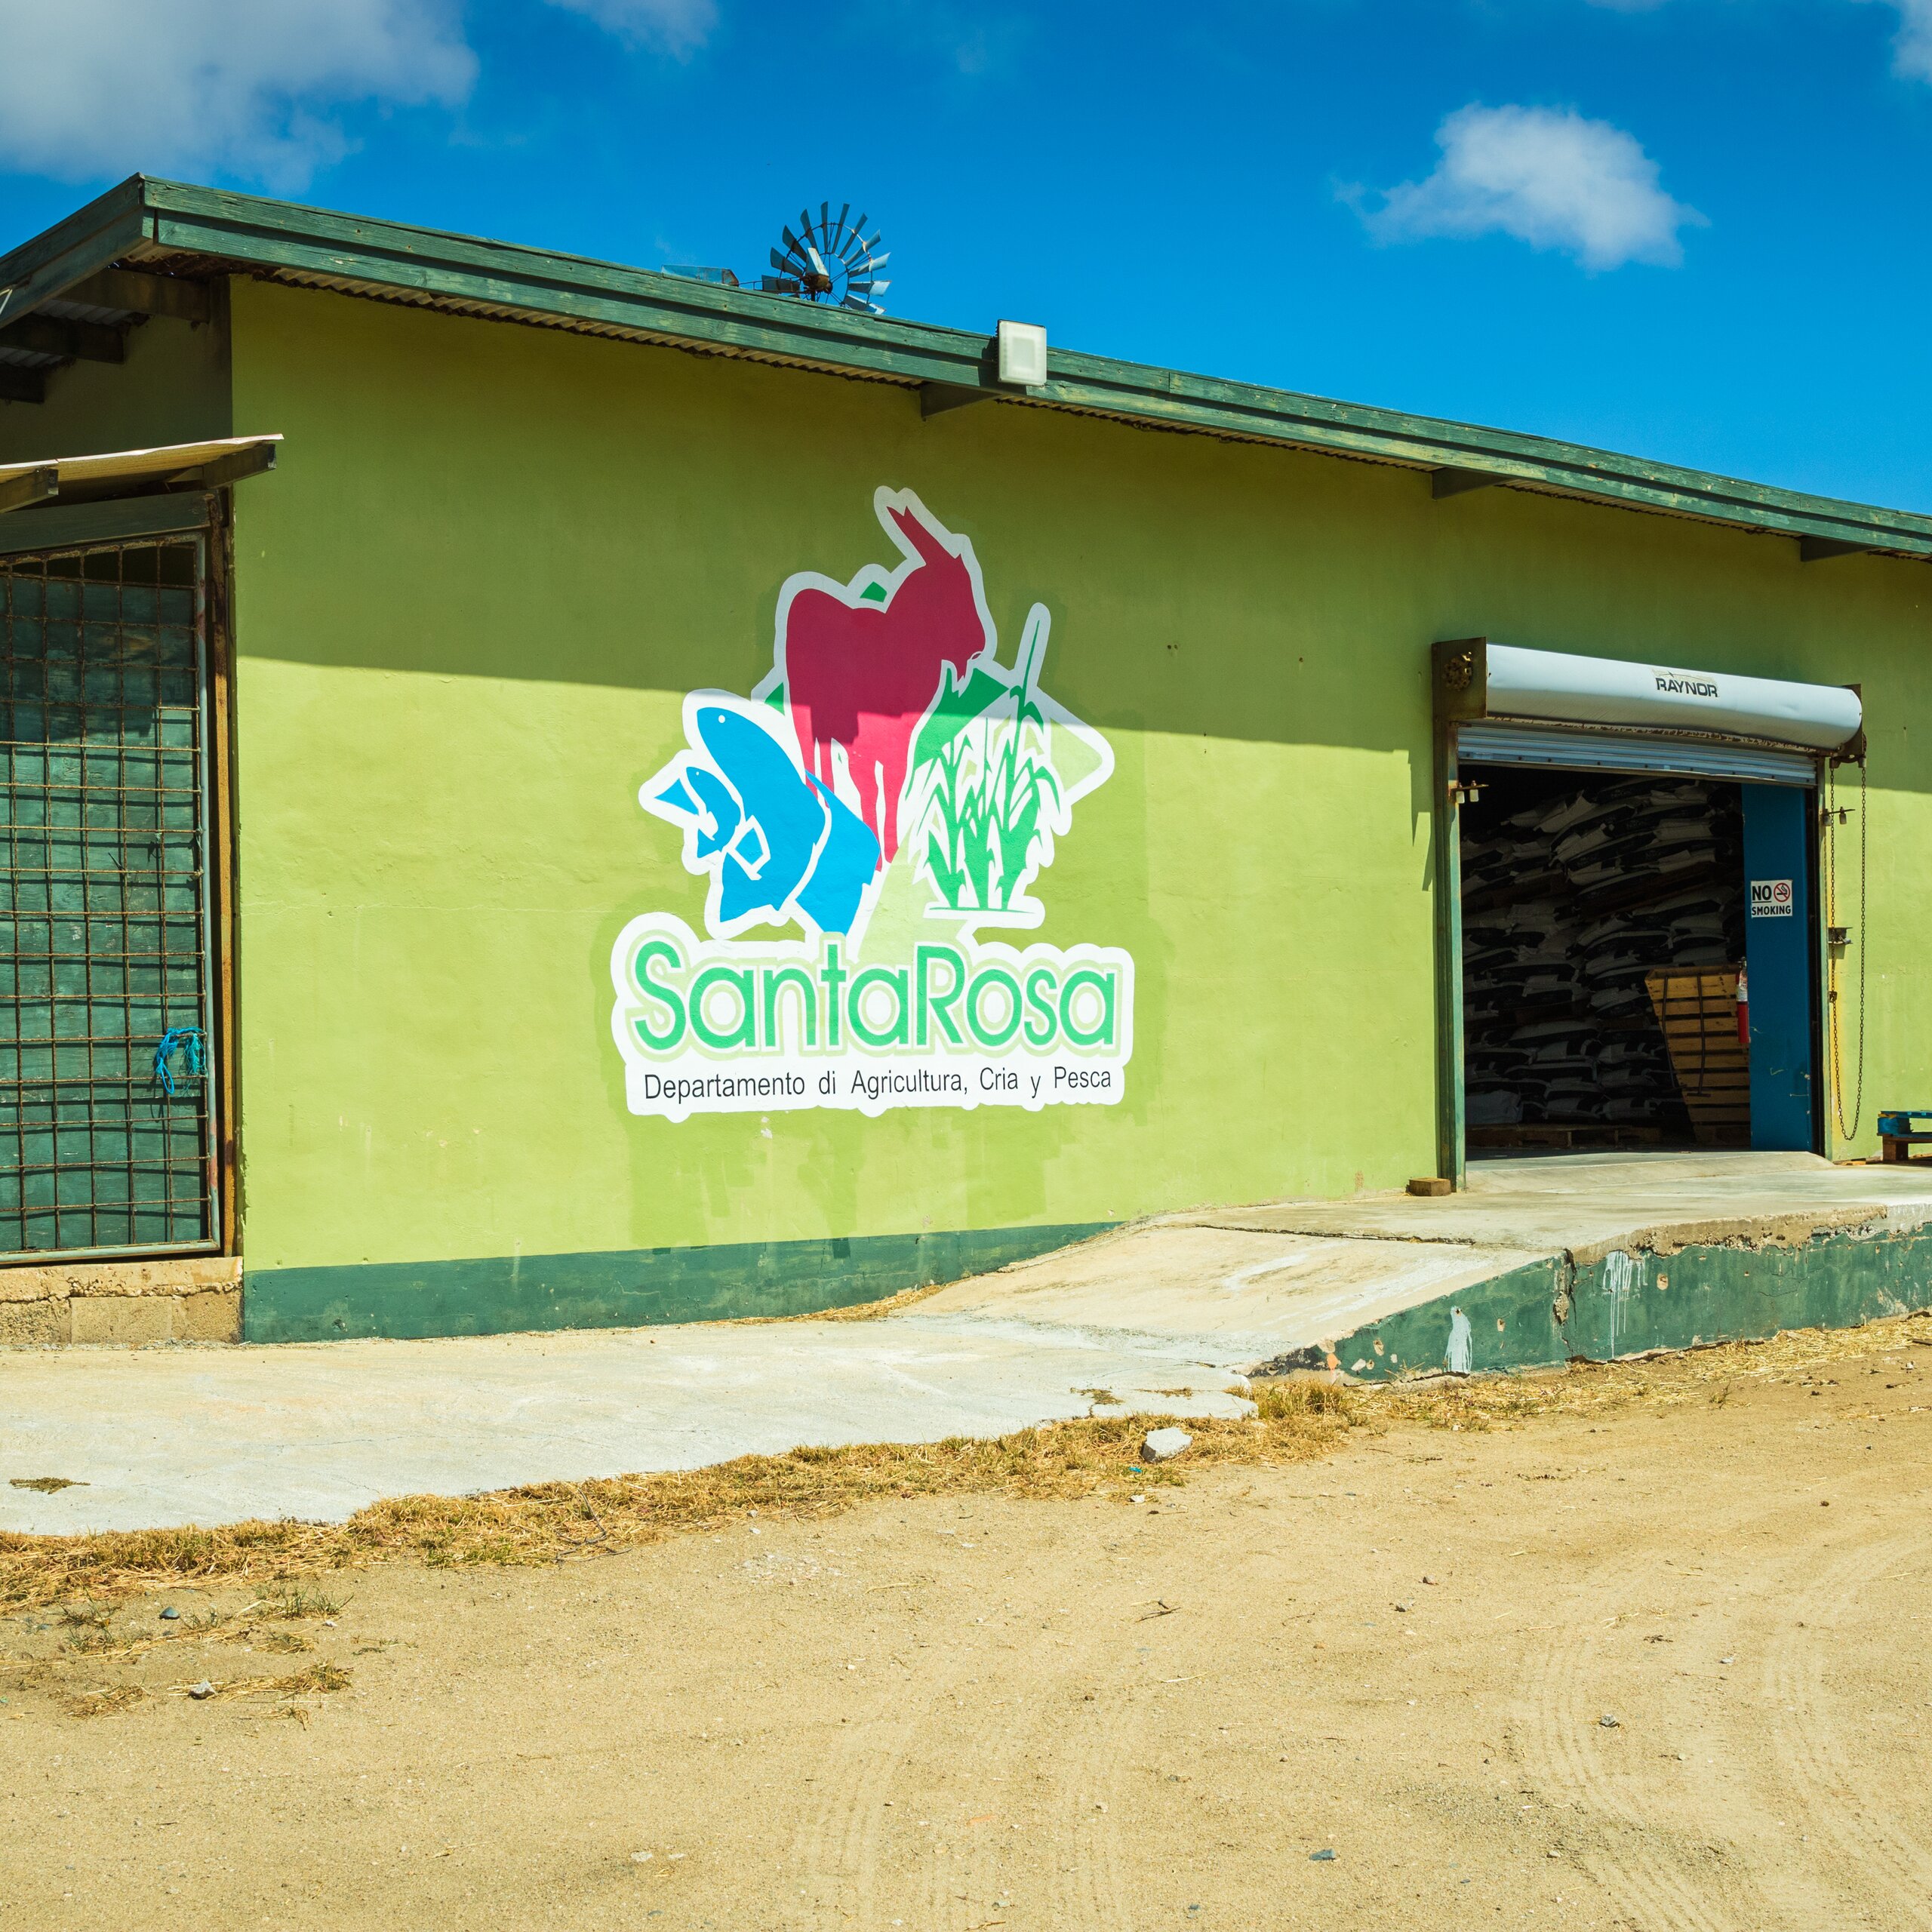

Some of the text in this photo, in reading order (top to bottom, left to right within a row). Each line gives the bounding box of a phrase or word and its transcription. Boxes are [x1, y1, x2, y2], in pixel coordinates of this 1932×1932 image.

[1655, 677, 1718, 698] RAYNOR
[1752, 885, 1772, 901] NO
[1752, 906, 1791, 915] SMOKING
[644, 1065, 1111, 1105] Departamento di Agricultura, Cria y Pesca
